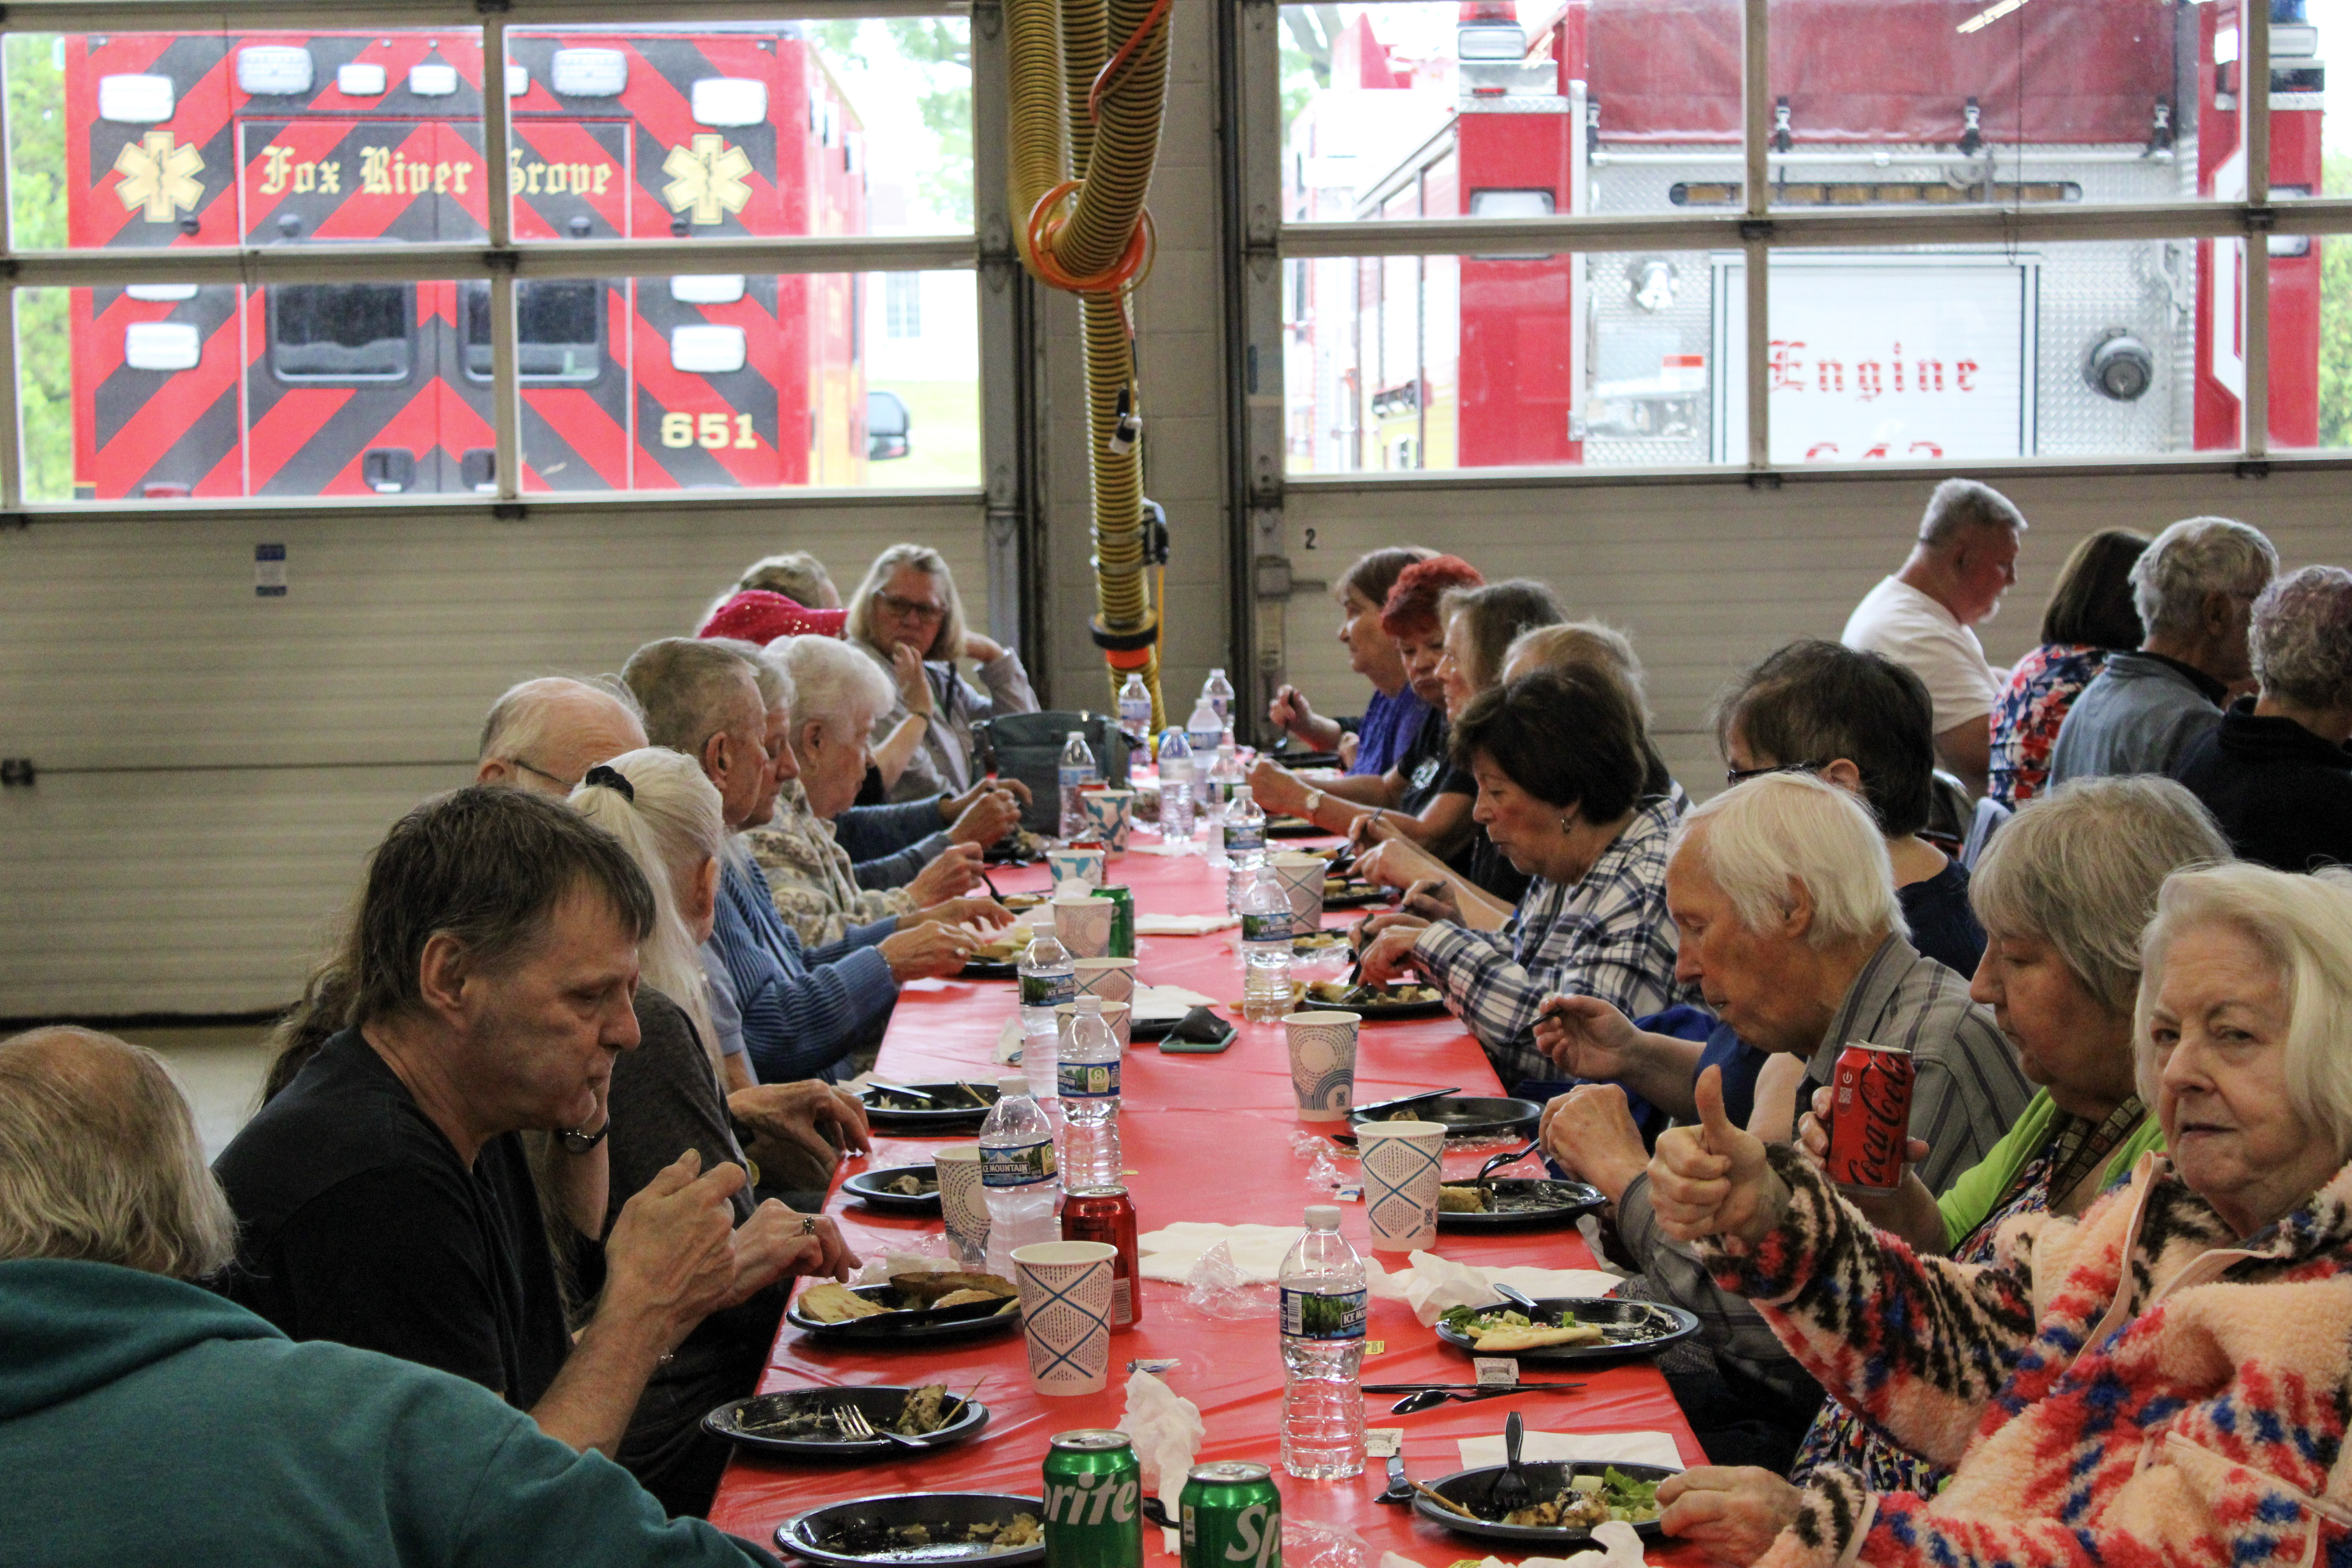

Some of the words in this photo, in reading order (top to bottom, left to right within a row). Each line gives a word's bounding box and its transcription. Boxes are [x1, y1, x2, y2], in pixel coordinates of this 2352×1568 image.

[259, 145, 341, 194] Fox
[360, 146, 473, 194] River
[1769, 340, 1979, 401] Engine
[661, 412, 757, 449] 651
[1305, 528, 1316, 549] 2
[1848, 1050, 1907, 1185] Coca-Cola
[989, 1164, 1028, 1173] MOUNTAIN
[1343, 1312, 1355, 1324] ICE
